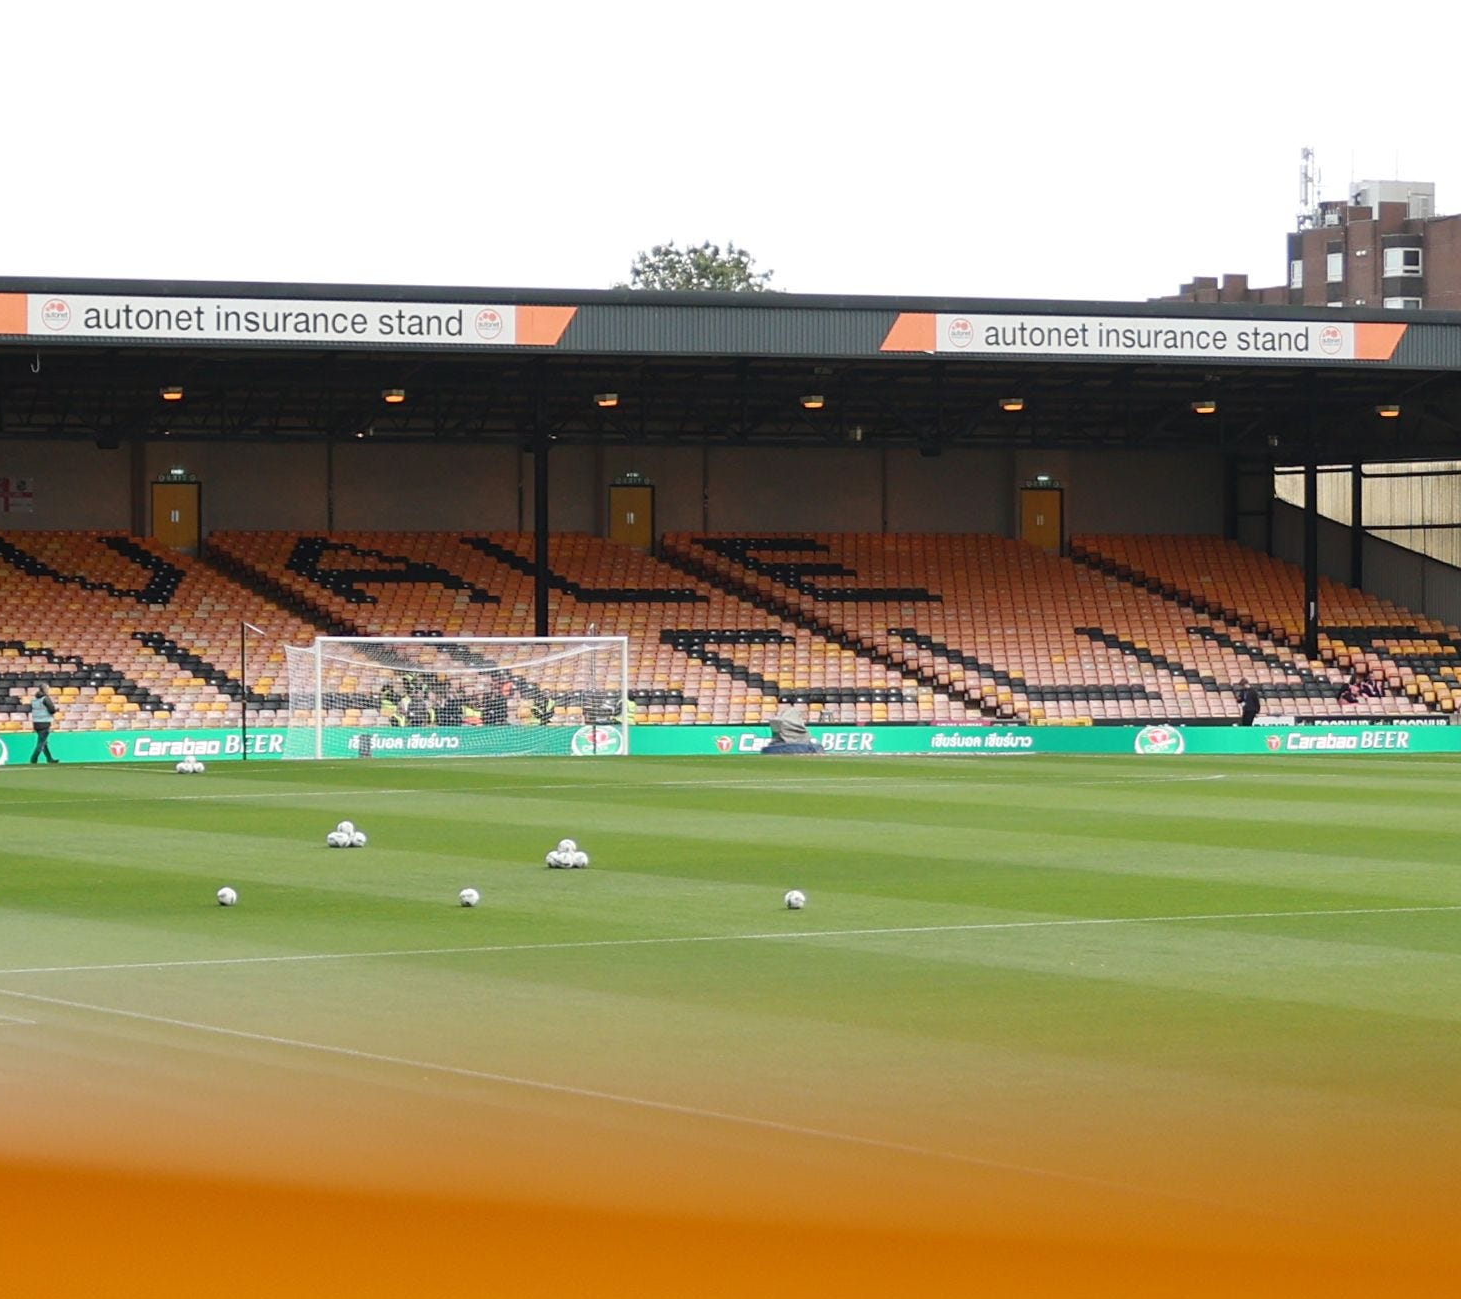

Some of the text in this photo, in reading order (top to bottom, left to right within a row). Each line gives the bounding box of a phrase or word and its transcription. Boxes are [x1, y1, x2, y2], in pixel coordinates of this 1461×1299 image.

[83, 304, 463, 336] autonet insurance stand
[984, 322, 1309, 352] autonet insurance stand
[133, 734, 284, 757] Carabao BEER
[348, 733, 403, 749] เชีร์บอล
[822, 732, 874, 751] BEER
[1286, 731, 1409, 750] Carabao BEER
